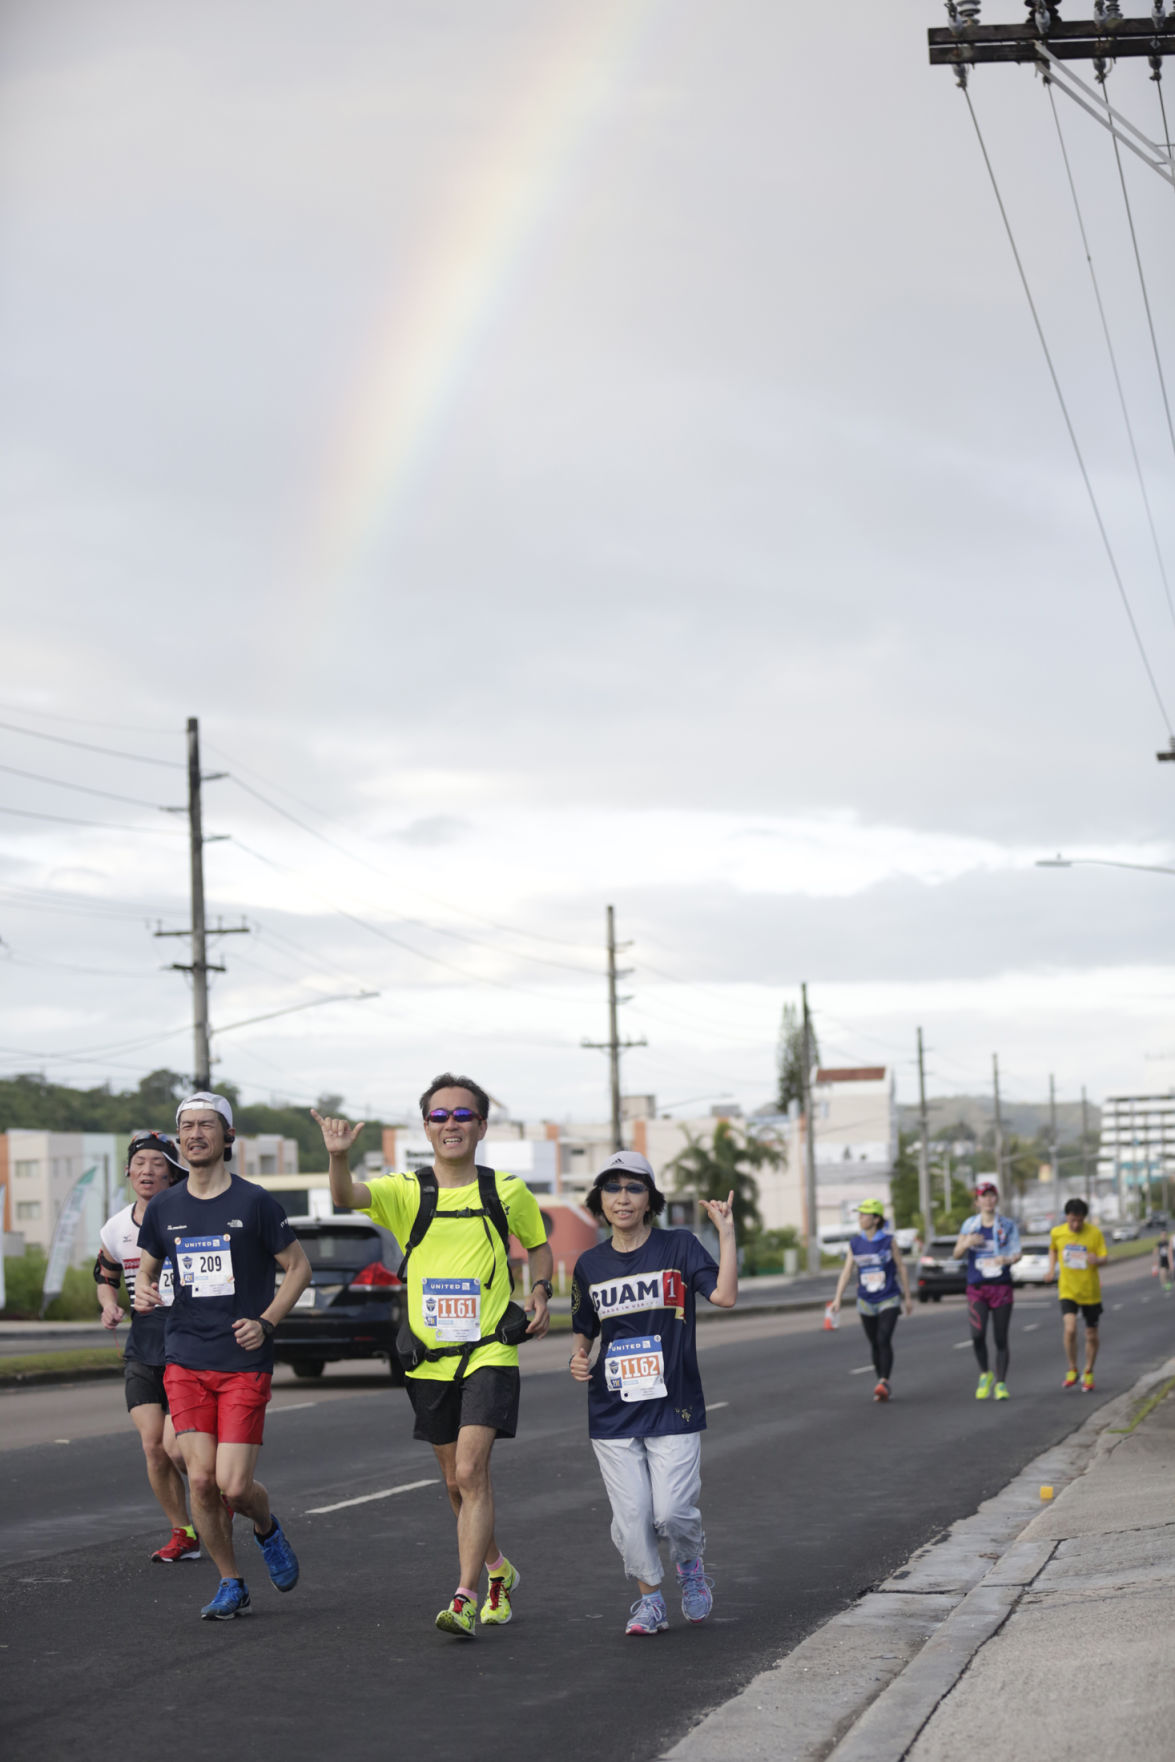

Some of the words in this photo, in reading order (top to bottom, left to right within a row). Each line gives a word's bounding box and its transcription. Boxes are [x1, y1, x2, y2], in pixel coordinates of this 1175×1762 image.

[200, 1255, 222, 1273] 209
[592, 1279, 660, 1312] GUAM
[667, 1276, 677, 1298] 1
[439, 1299, 474, 1318] 1161
[611, 1343, 641, 1352] UNITED
[622, 1357, 658, 1379] 1162
